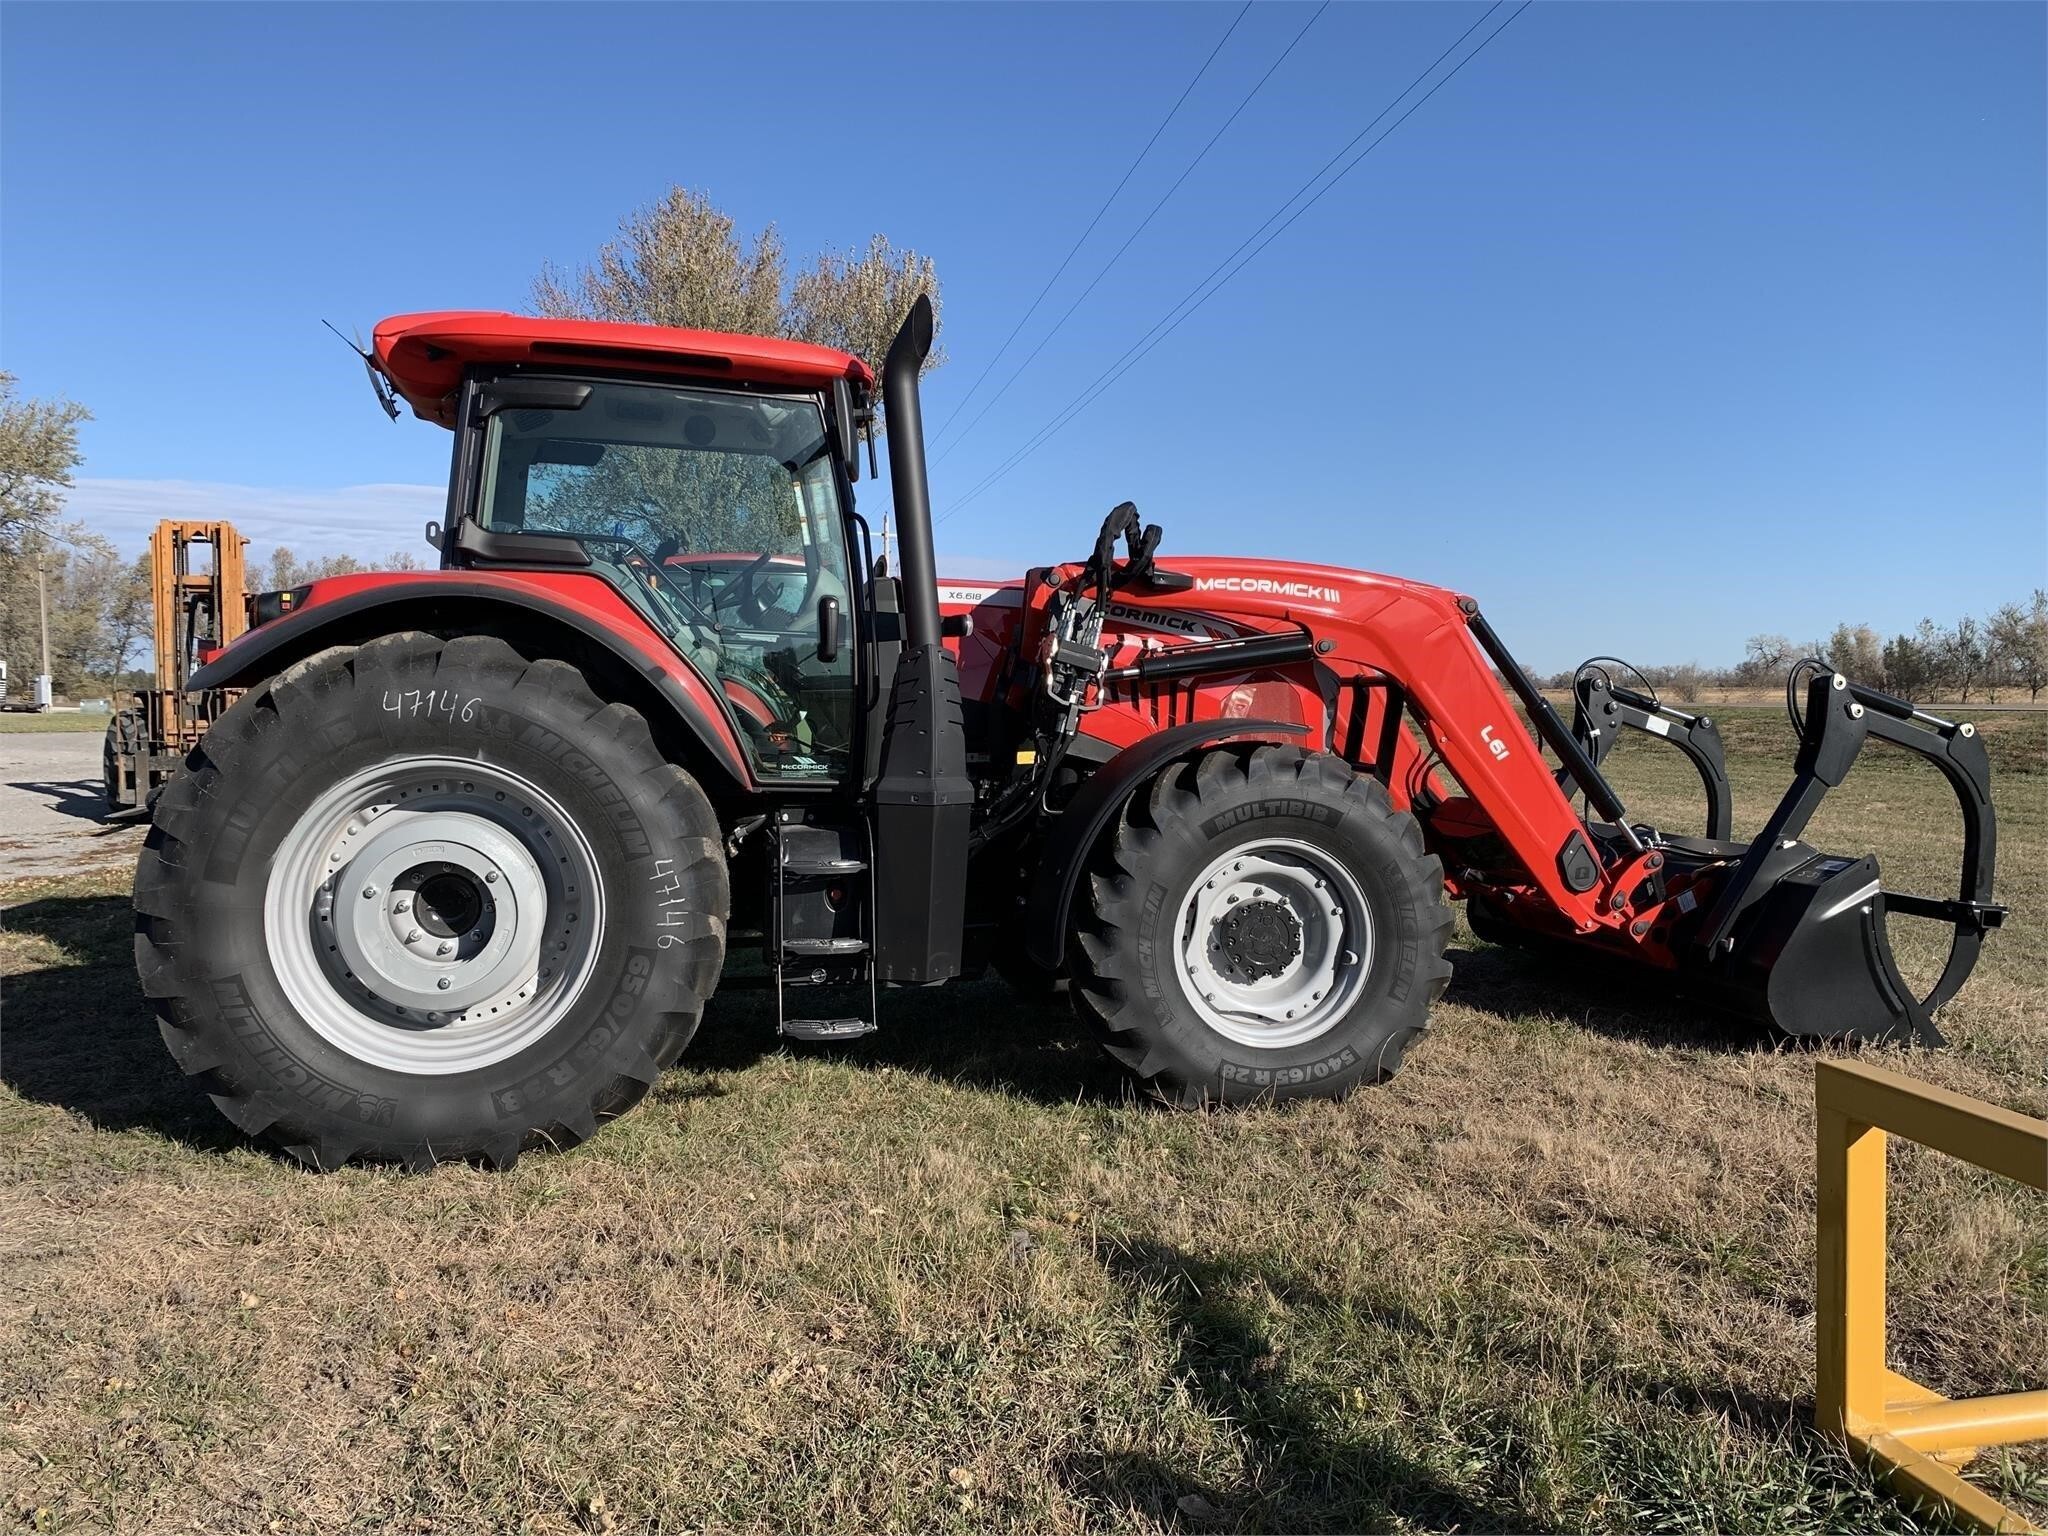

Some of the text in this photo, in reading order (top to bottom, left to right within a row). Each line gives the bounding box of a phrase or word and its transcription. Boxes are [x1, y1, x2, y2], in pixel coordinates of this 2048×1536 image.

[948, 591, 982, 601] X6.618
[1196, 577, 1323, 600] McCORMICK
[382, 689, 482, 724] 47146
[1480, 724, 1511, 761] L61
[519, 722, 649, 855] MICHELIN
[1213, 801, 1329, 832] MULTIBIB
[649, 859, 689, 949] 47146
[1138, 885, 1163, 998] MICHELIN
[214, 983, 352, 1112] MICHELIN
[499, 954, 652, 1113] 650/65 R 38
[1221, 1049, 1356, 1086] 540/65 R 28
